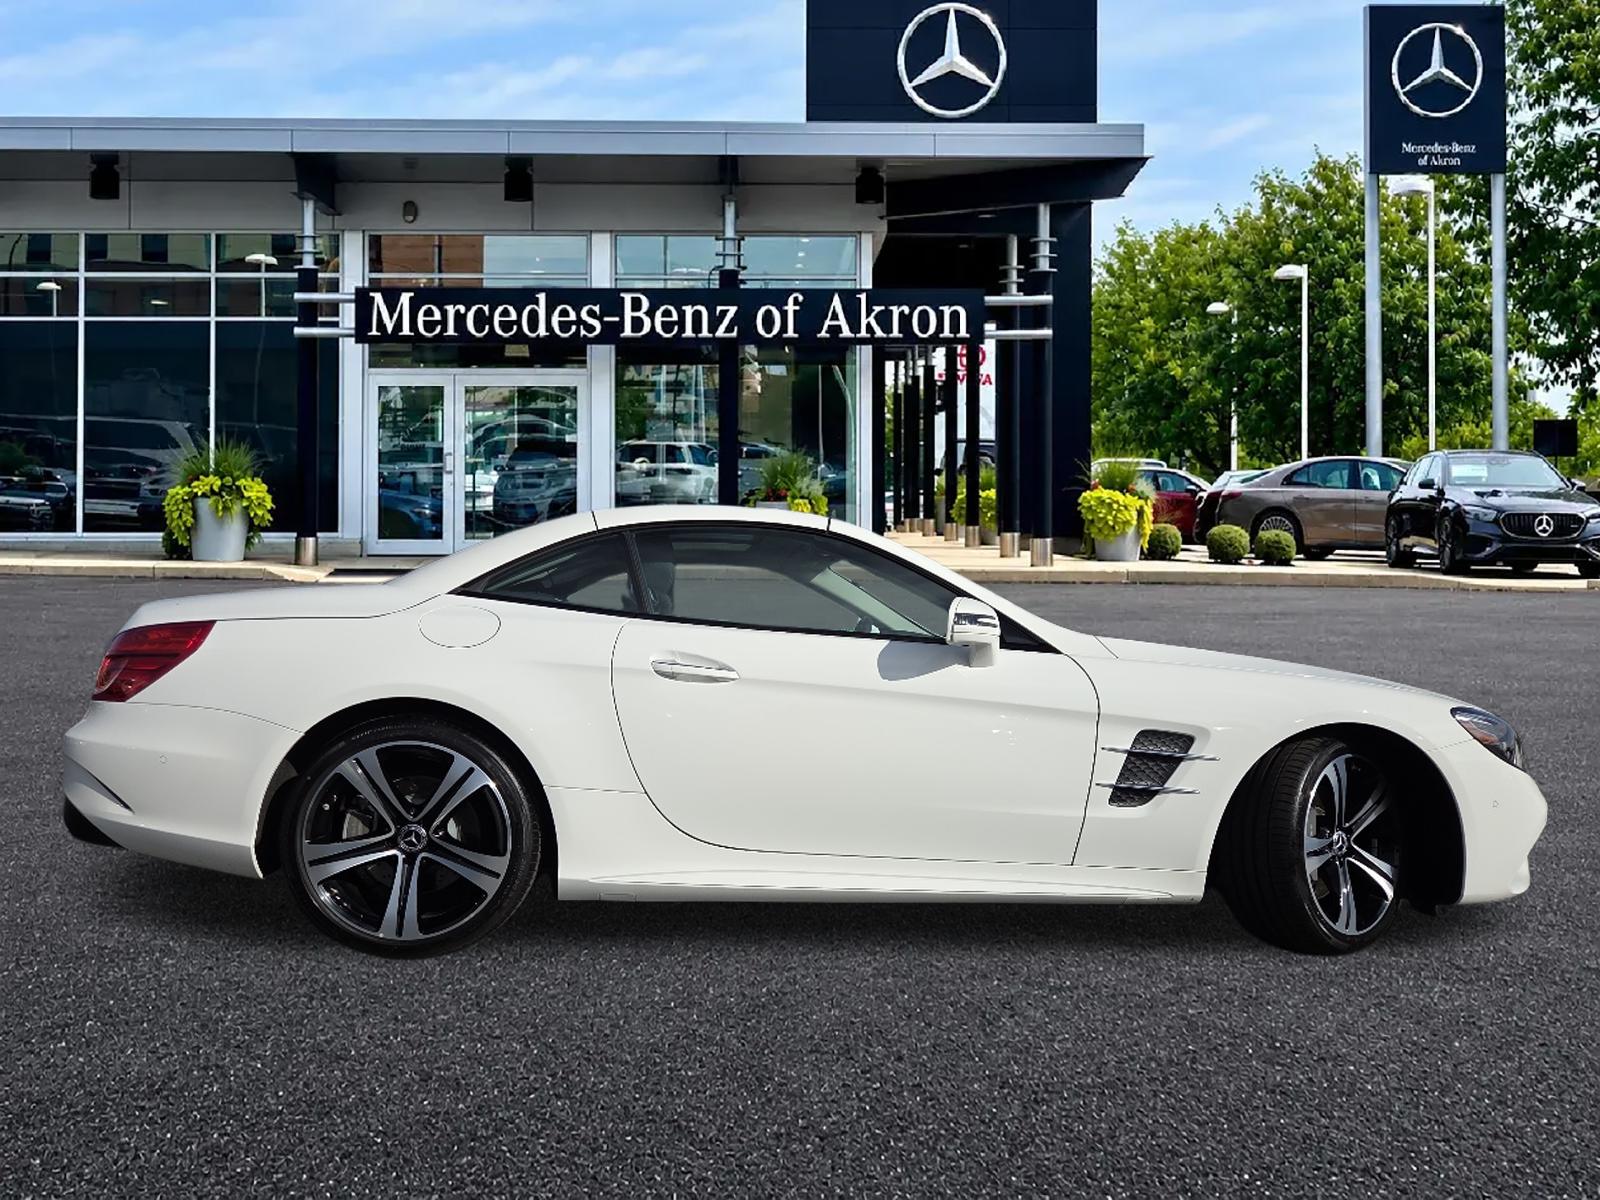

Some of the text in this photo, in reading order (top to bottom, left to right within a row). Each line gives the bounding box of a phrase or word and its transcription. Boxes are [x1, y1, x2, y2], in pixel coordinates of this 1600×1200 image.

[1401, 141, 1476, 153] Mercedes-Benz
[1417, 154, 1461, 166] of Akron
[367, 292, 970, 339] Mercedes-Benz of Akron
